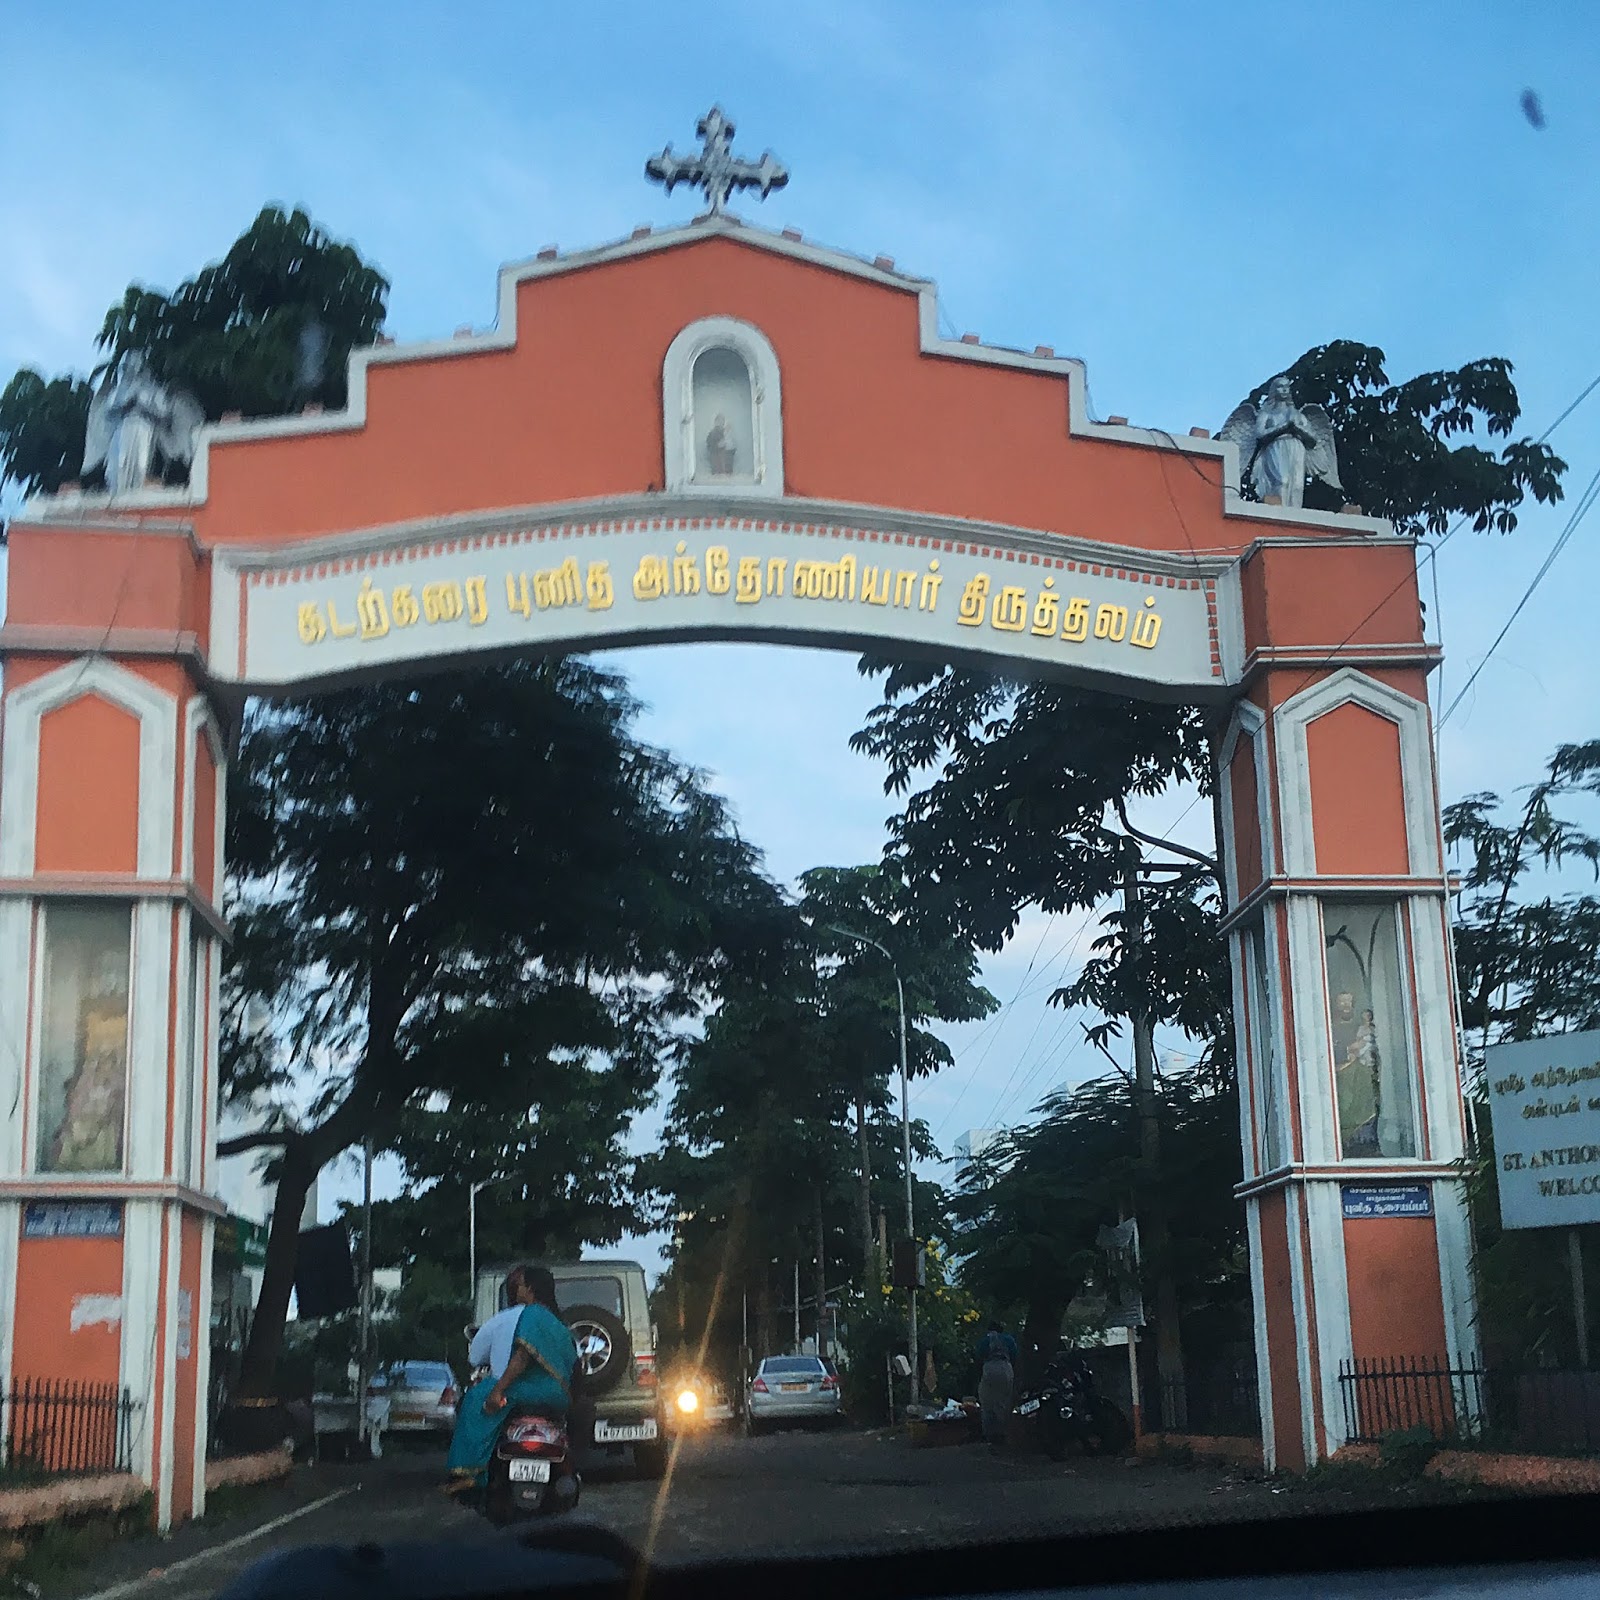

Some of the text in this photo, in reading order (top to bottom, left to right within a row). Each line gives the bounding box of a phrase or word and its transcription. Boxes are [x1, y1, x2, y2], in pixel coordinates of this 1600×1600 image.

[297, 540, 1163, 649] கடற்கரை புனித அந்தோணியார் திருத்தலம்
